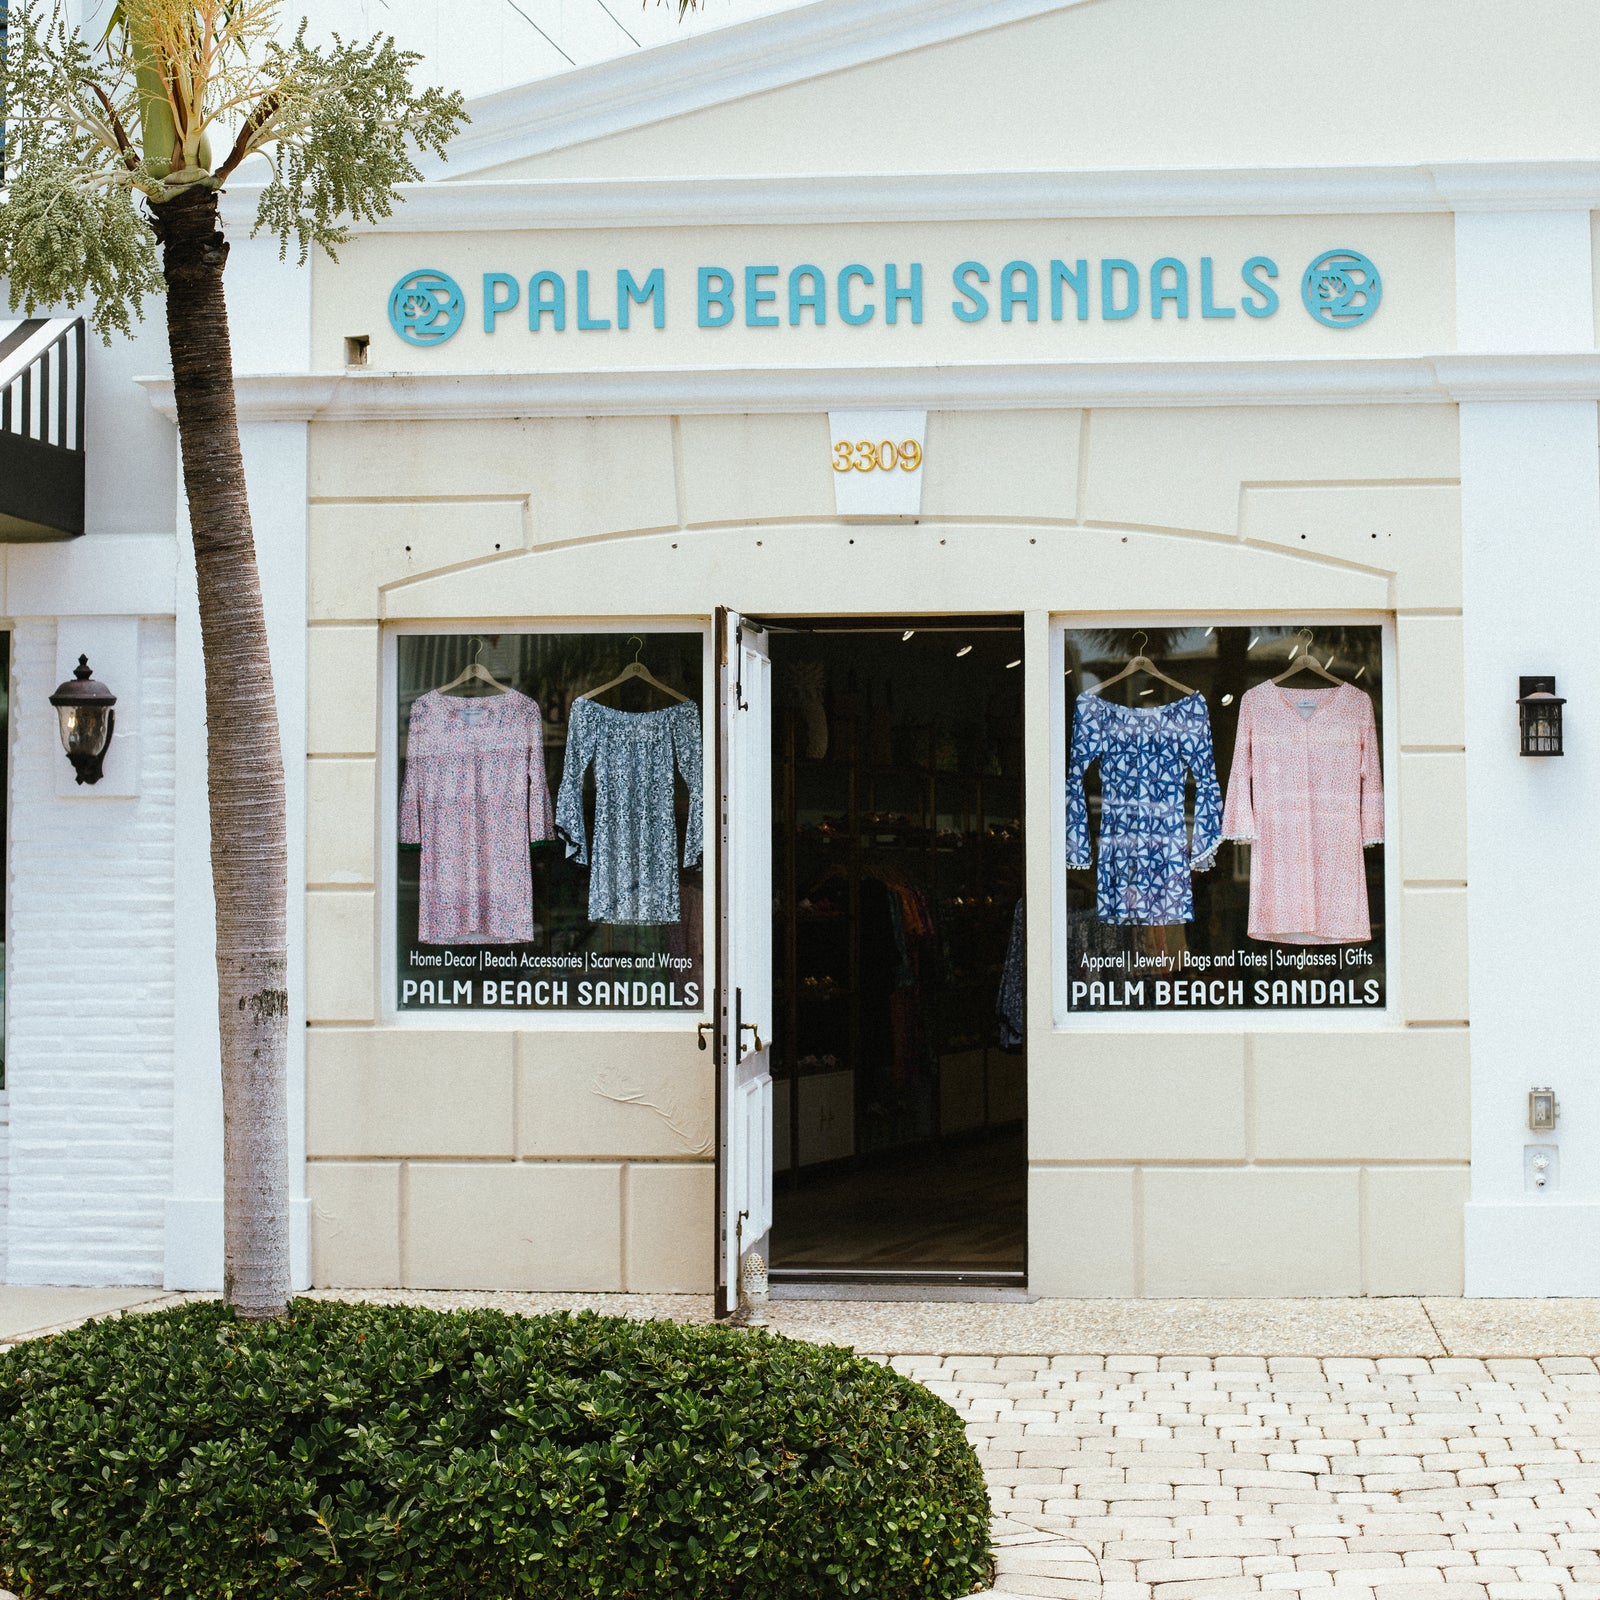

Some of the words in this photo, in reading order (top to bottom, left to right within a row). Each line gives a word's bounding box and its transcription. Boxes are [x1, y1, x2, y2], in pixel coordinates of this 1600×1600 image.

[483, 268, 664, 332] PALM
[698, 263, 922, 327] BEACH
[952, 256, 1279, 322] SANDALS
[832, 439, 922, 473] 3309
[410, 950, 442, 967] Home
[444, 950, 477, 967] Decor
[484, 951, 518, 968] Beach
[519, 951, 583, 968] Accessories
[590, 951, 633, 969] Scarves
[634, 951, 655, 969] and
[657, 952, 693, 973] Wraps
[1080, 950, 1125, 973] Apparel
[1133, 950, 1176, 972] Jewelry
[1183, 950, 1211, 971] Bags
[1213, 949, 1235, 967] and
[1237, 950, 1268, 967] Totes
[1276, 948, 1337, 970] Sunglasses
[1345, 947, 1373, 966] Gifts
[402, 979, 473, 1005] PALM
[482, 980, 568, 1006] BEACH
[577, 981, 699, 1006] SANDALS
[1072, 980, 1145, 1006] PALM
[1155, 980, 1244, 1006] BEACH
[1253, 978, 1380, 1005] SANDALS
